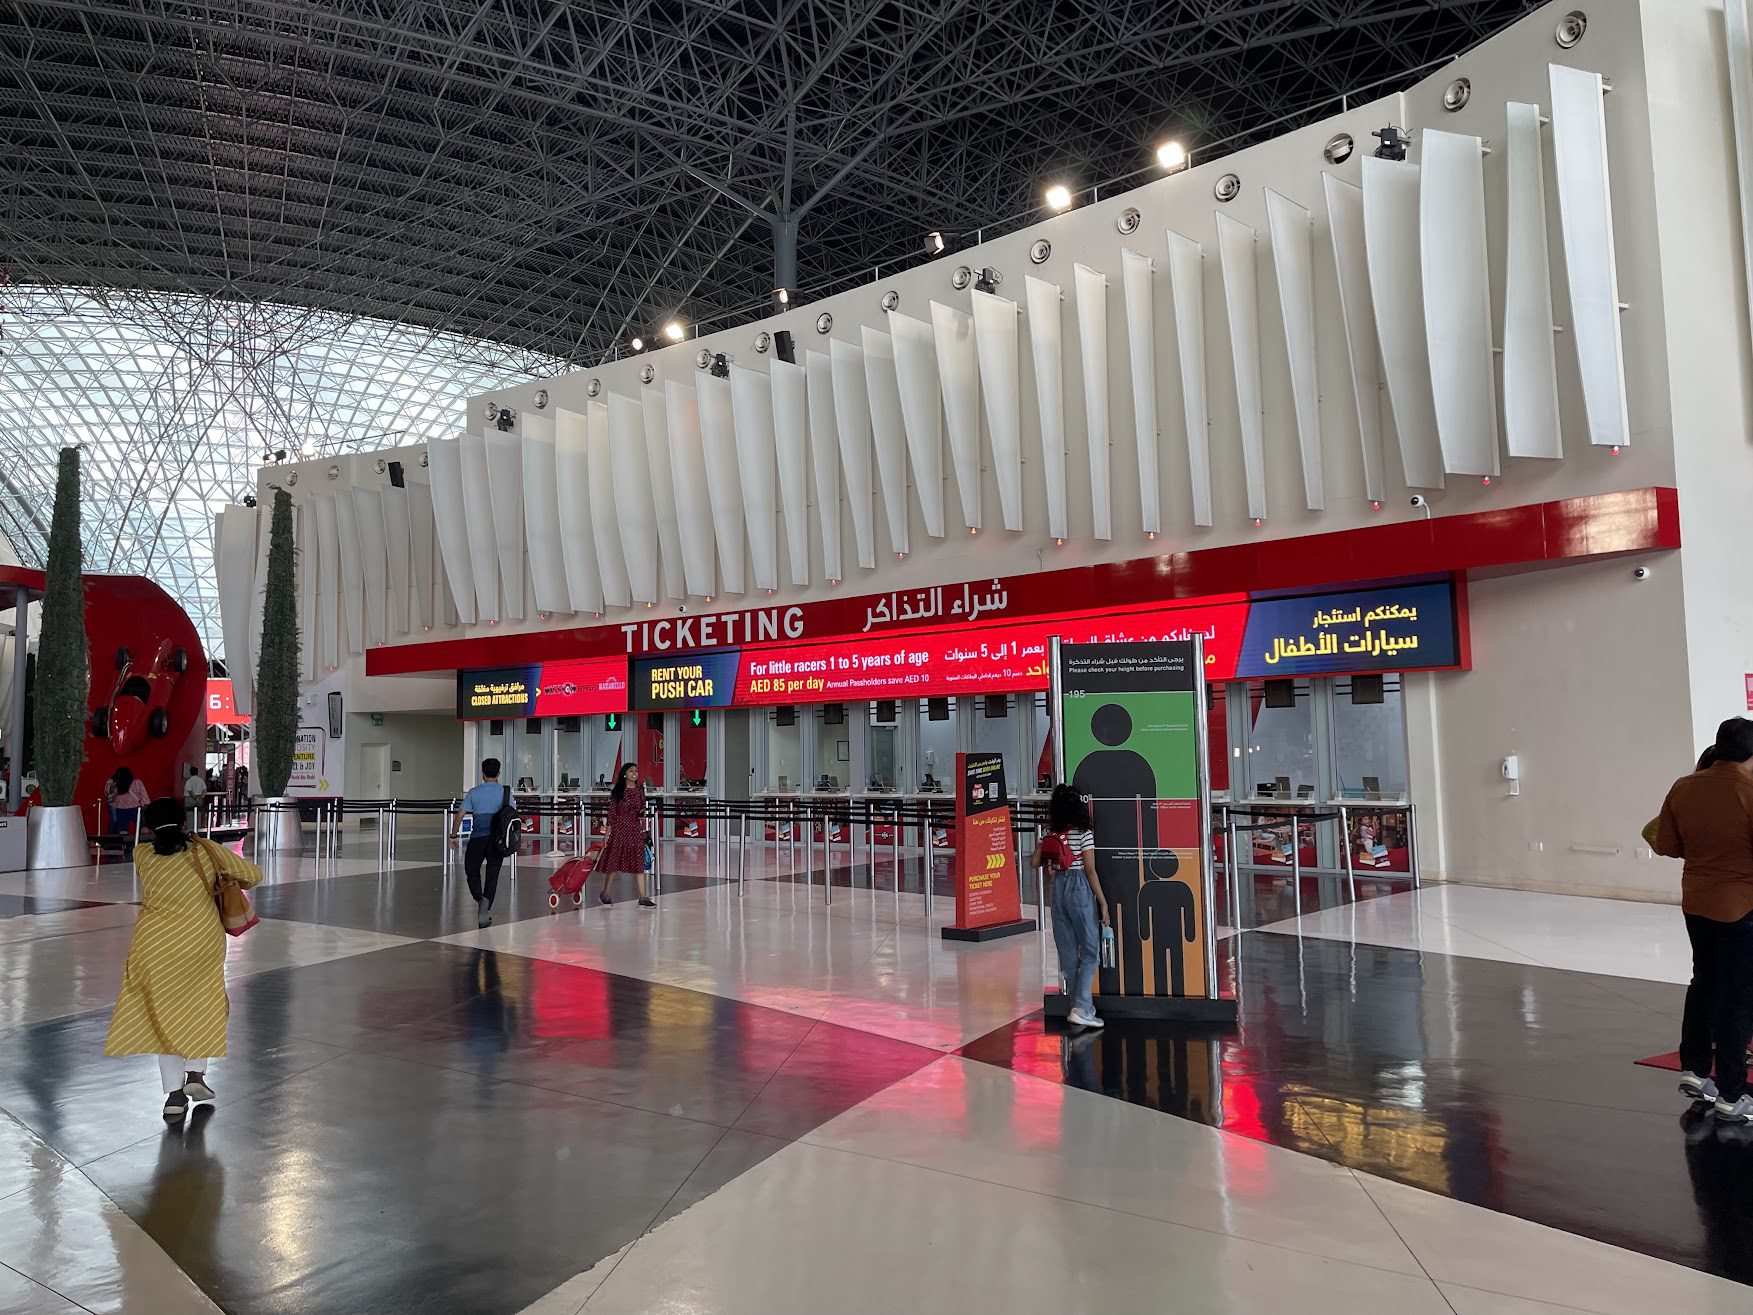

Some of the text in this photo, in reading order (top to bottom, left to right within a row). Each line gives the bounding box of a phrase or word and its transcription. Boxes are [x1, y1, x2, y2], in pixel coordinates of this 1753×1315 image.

[862, 578, 1008, 633] شراء التذاكر
[1312, 604, 1418, 629] يمكنكم استئجار
[620, 606, 804, 653] TICKETING
[980, 643, 988, 658] 5
[991, 643, 1007, 660] إلى
[1010, 640, 1017, 655] 1
[1021, 644, 1045, 658] بعمر
[1264, 629, 1419, 664] سيارات الأطفال
[751, 649, 929, 675] For little racers 1 to 5 years of age
[944, 647, 978, 662] سنوات
[651, 665, 703, 681] RENT YOUR
[1002, 668, 1012, 678] 10
[1154, 664, 1185, 673] purchasing
[750, 675, 825, 694] AED 85 per day
[826, 680, 849, 688] Annual
[849, 677, 887, 687] Passholders
[904, 674, 920, 684] AED
[921, 674, 930, 683] 10
[651, 679, 714, 700] PUSH CAR
[1068, 689, 1086, 699] 195
[471, 692, 528, 706] CLOSED ATTRACTIONS
[305, 761, 316, 770] JOY
